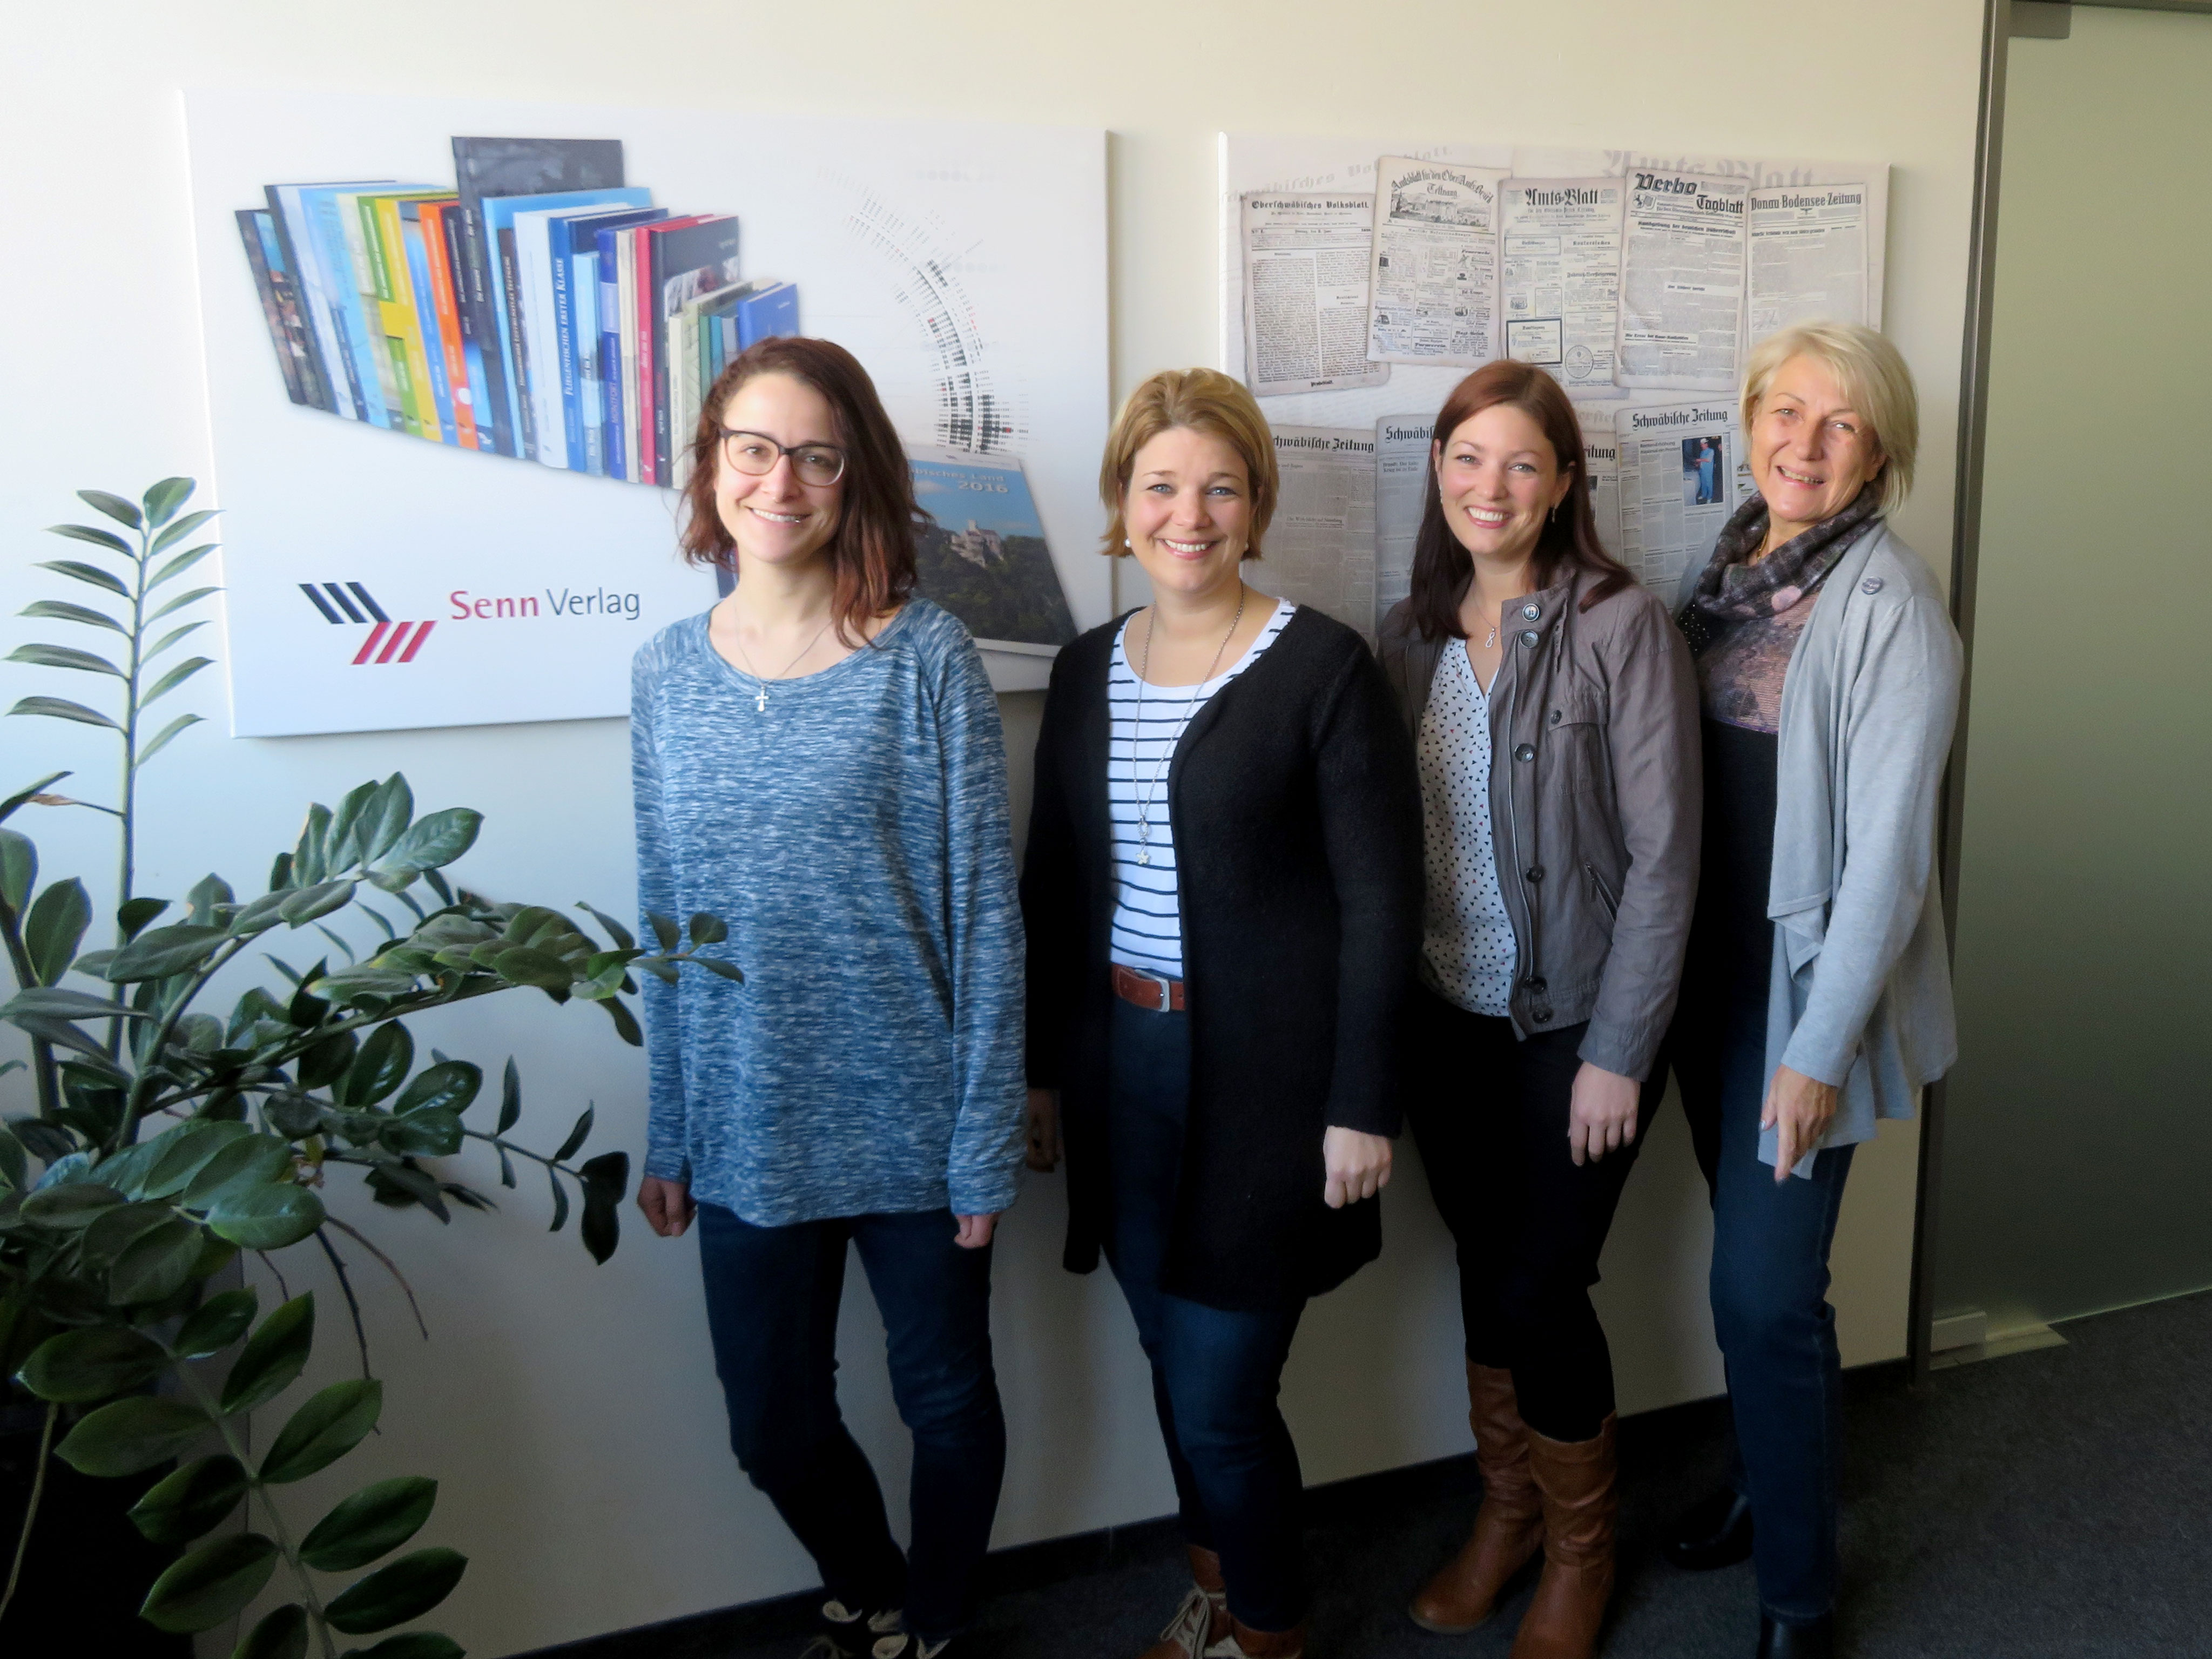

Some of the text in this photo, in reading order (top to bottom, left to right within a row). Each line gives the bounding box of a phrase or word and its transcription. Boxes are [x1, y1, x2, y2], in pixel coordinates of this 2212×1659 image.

[1634, 172, 1698, 195] Verbo
[1696, 194, 1744, 214] Tagblatt
[1632, 410, 1690, 431] Schwäbische
[1691, 408, 1728, 426] Zeitung
[1384, 425, 1434, 443] Schwäbis
[1273, 435, 1374, 454] chwäbische Zeitung
[1585, 443, 1616, 461] itung
[449, 587, 640, 621] Senn Verlag
